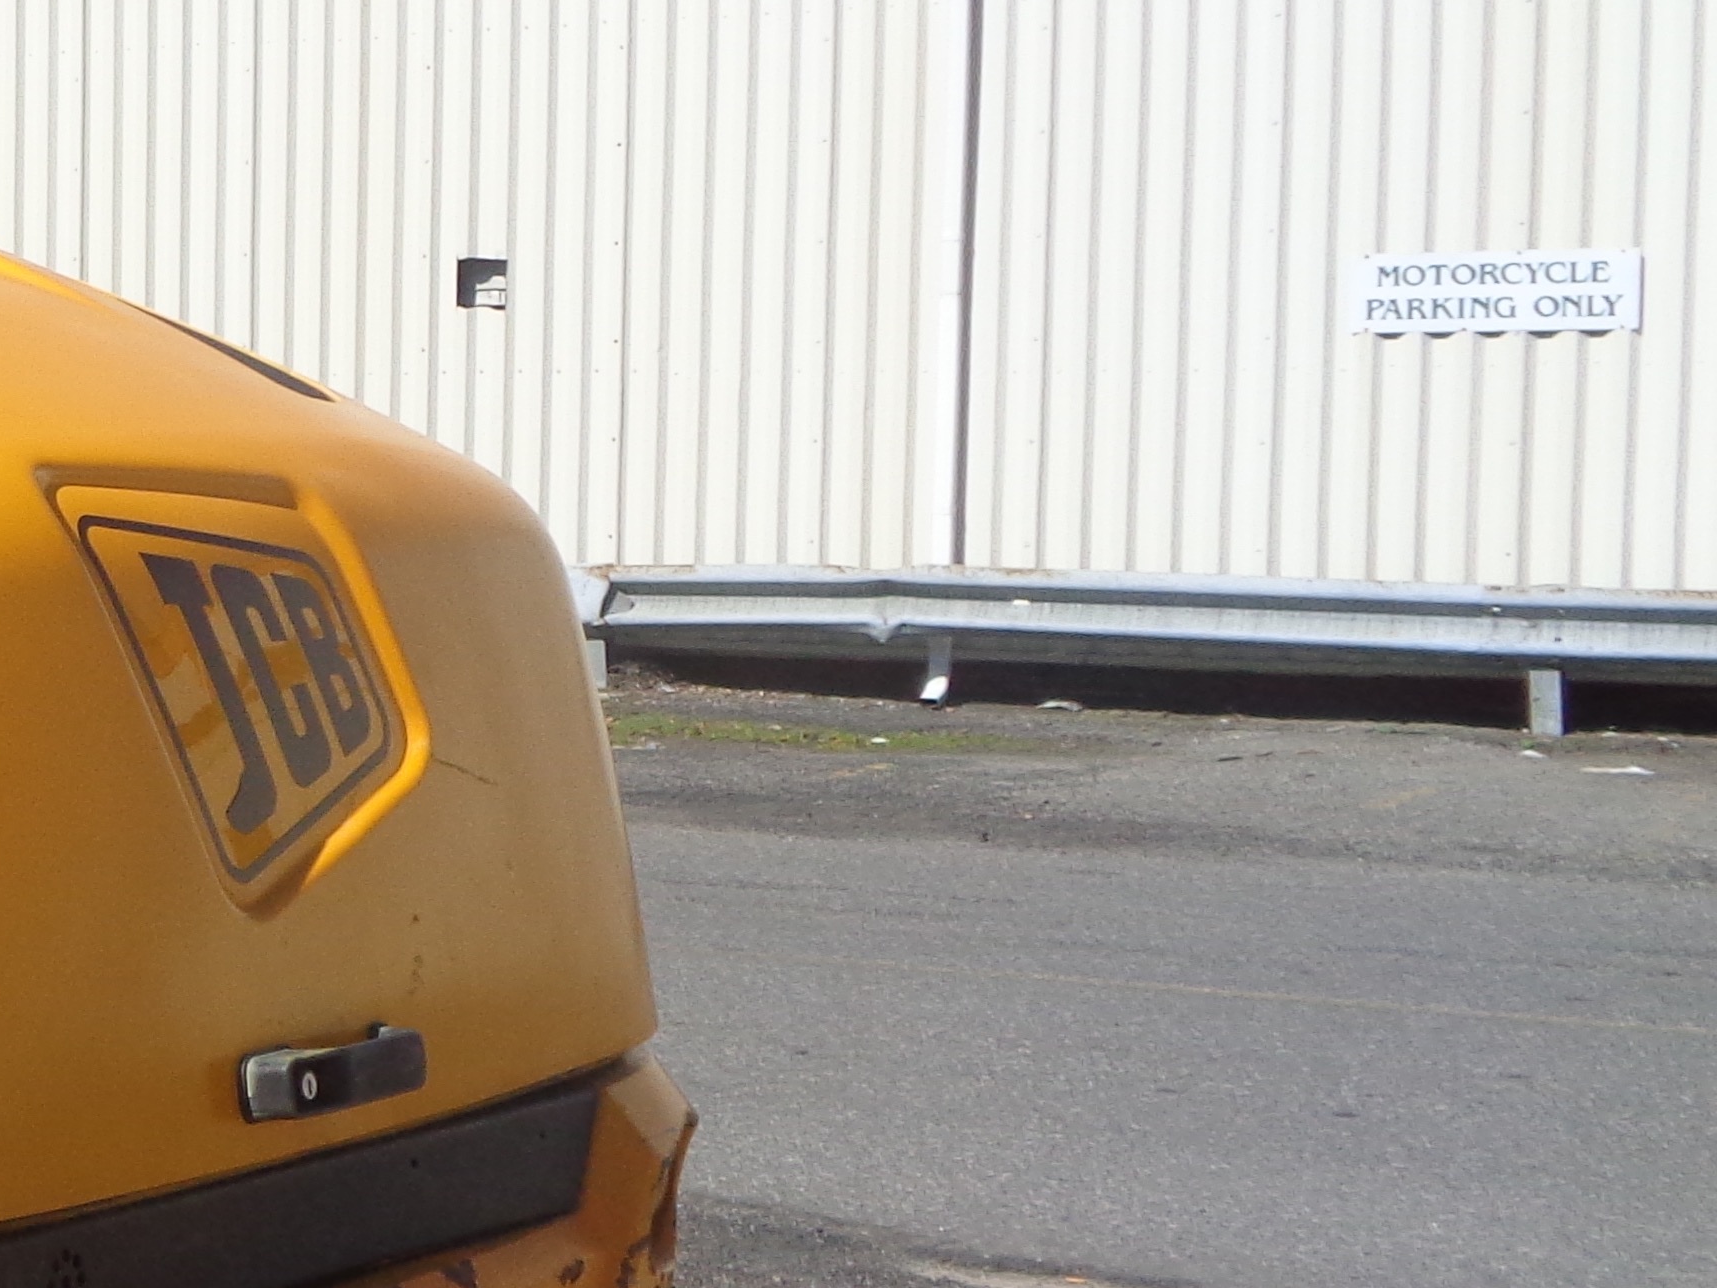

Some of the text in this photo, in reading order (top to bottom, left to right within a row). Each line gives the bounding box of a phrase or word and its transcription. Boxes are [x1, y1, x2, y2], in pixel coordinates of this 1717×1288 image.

[1376, 260, 1611, 288] MOTORCYCLE
[1365, 293, 1624, 321] PARKING ONLY
[138, 551, 370, 835] JCB
